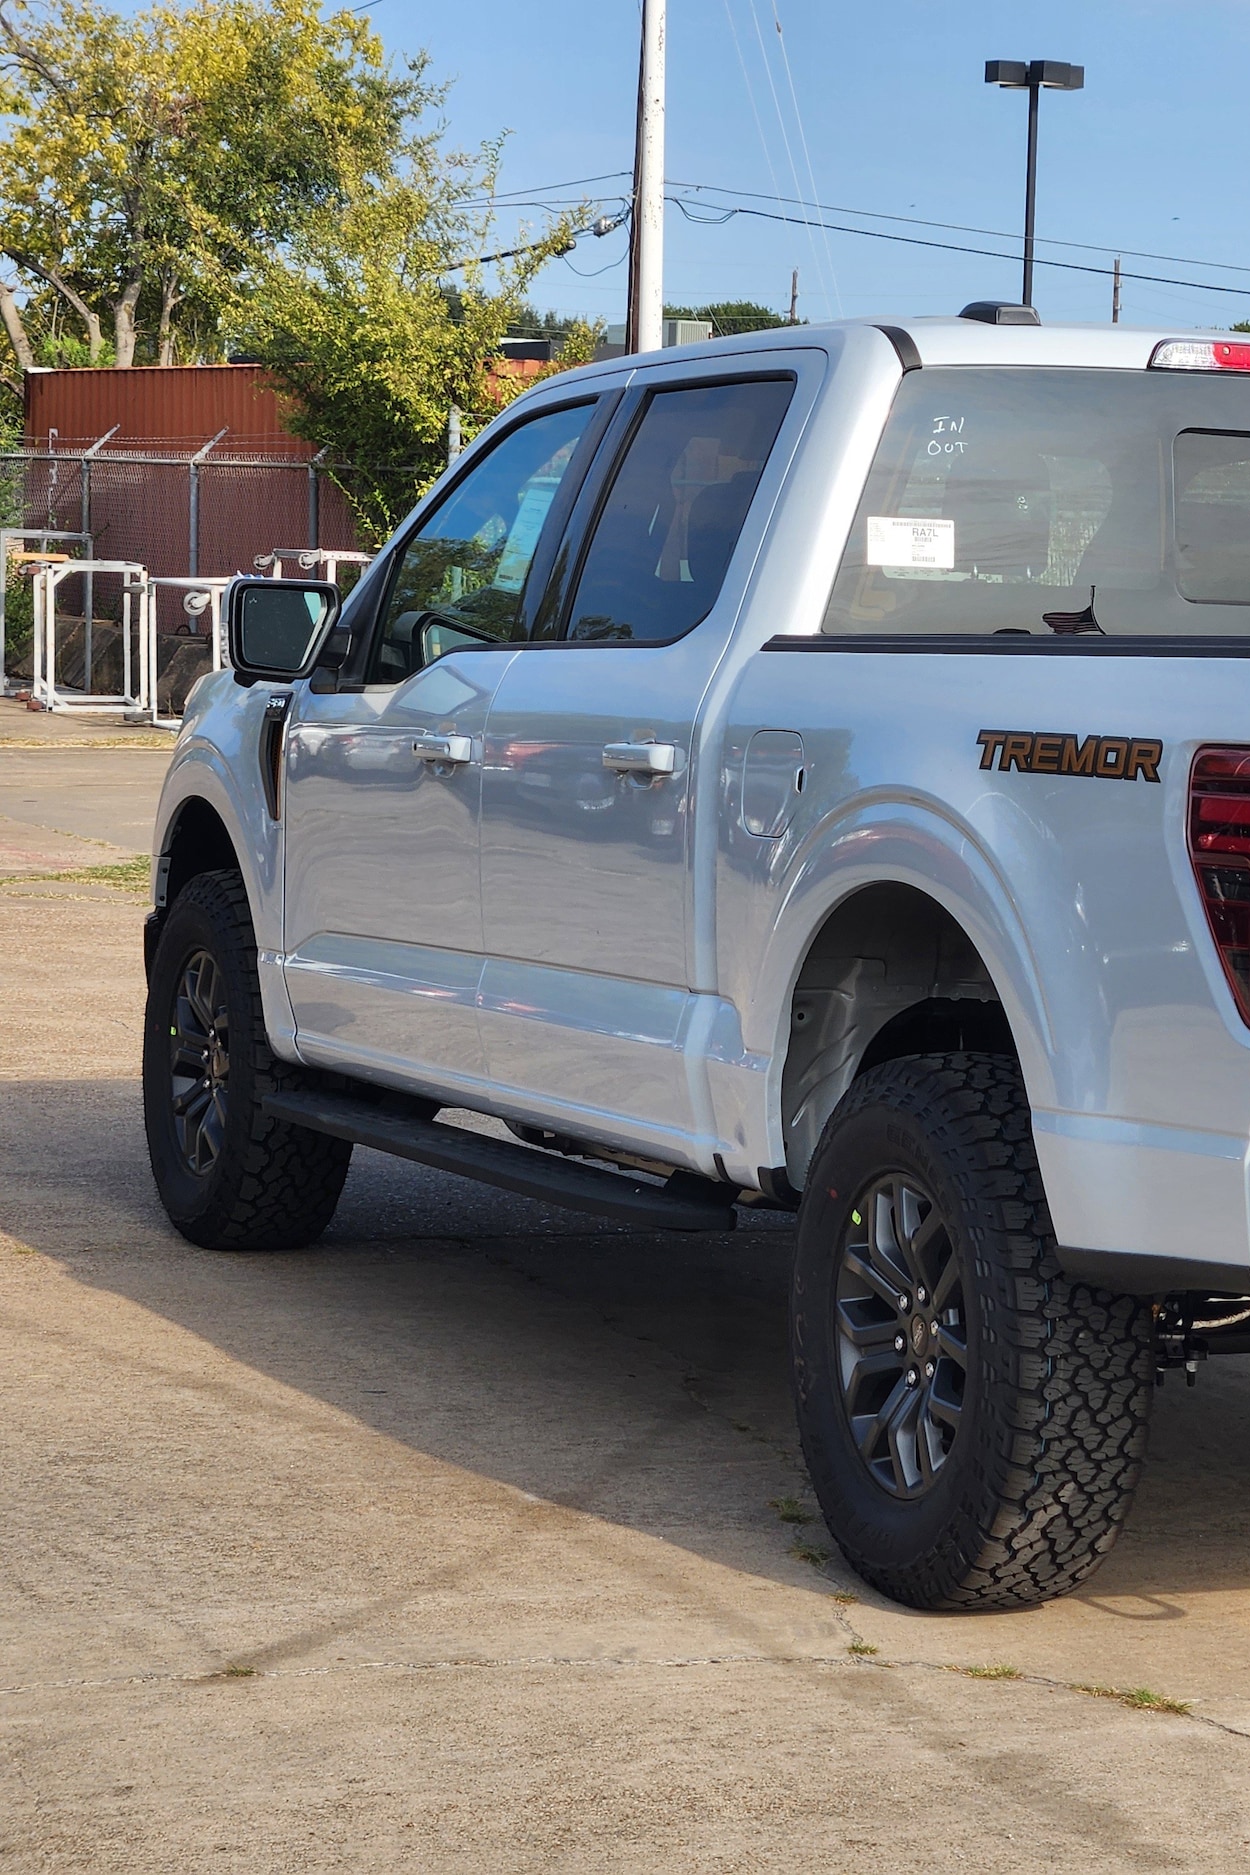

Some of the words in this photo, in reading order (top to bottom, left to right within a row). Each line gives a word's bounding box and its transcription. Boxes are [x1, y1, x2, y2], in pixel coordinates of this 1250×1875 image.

[932, 416, 965, 434] IN
[927, 440, 969, 456] OUT
[912, 527, 939, 537] RA7L
[976, 729, 1164, 783] TREMOR
